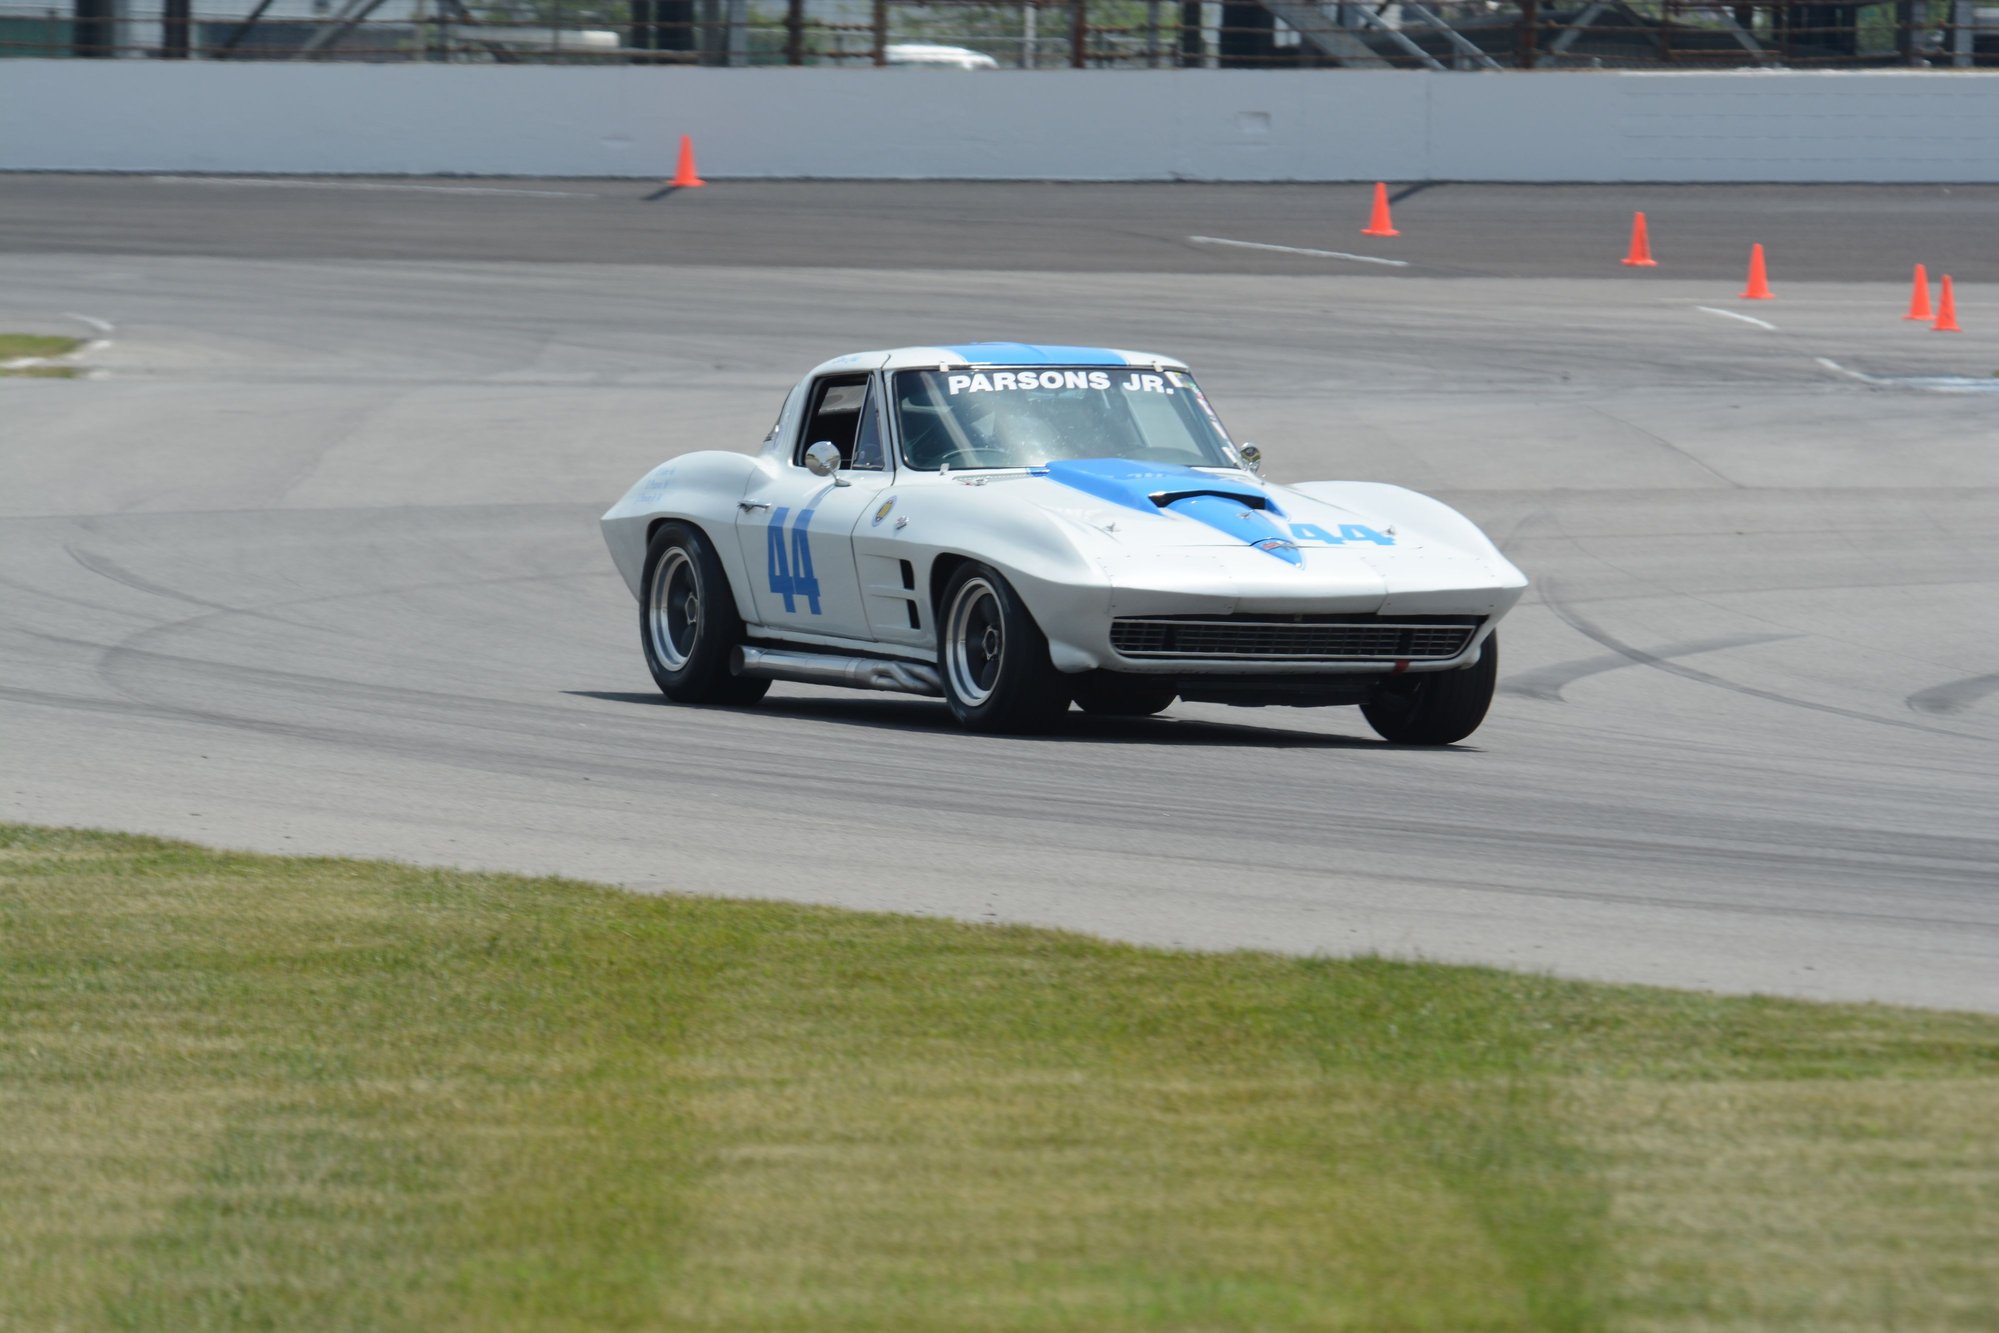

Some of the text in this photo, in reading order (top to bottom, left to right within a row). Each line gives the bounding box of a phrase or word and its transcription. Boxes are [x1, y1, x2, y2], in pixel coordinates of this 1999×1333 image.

[948, 371, 1174, 395] PARSONS JR.
[1289, 523, 1396, 545] 44
[768, 507, 822, 615] 44
